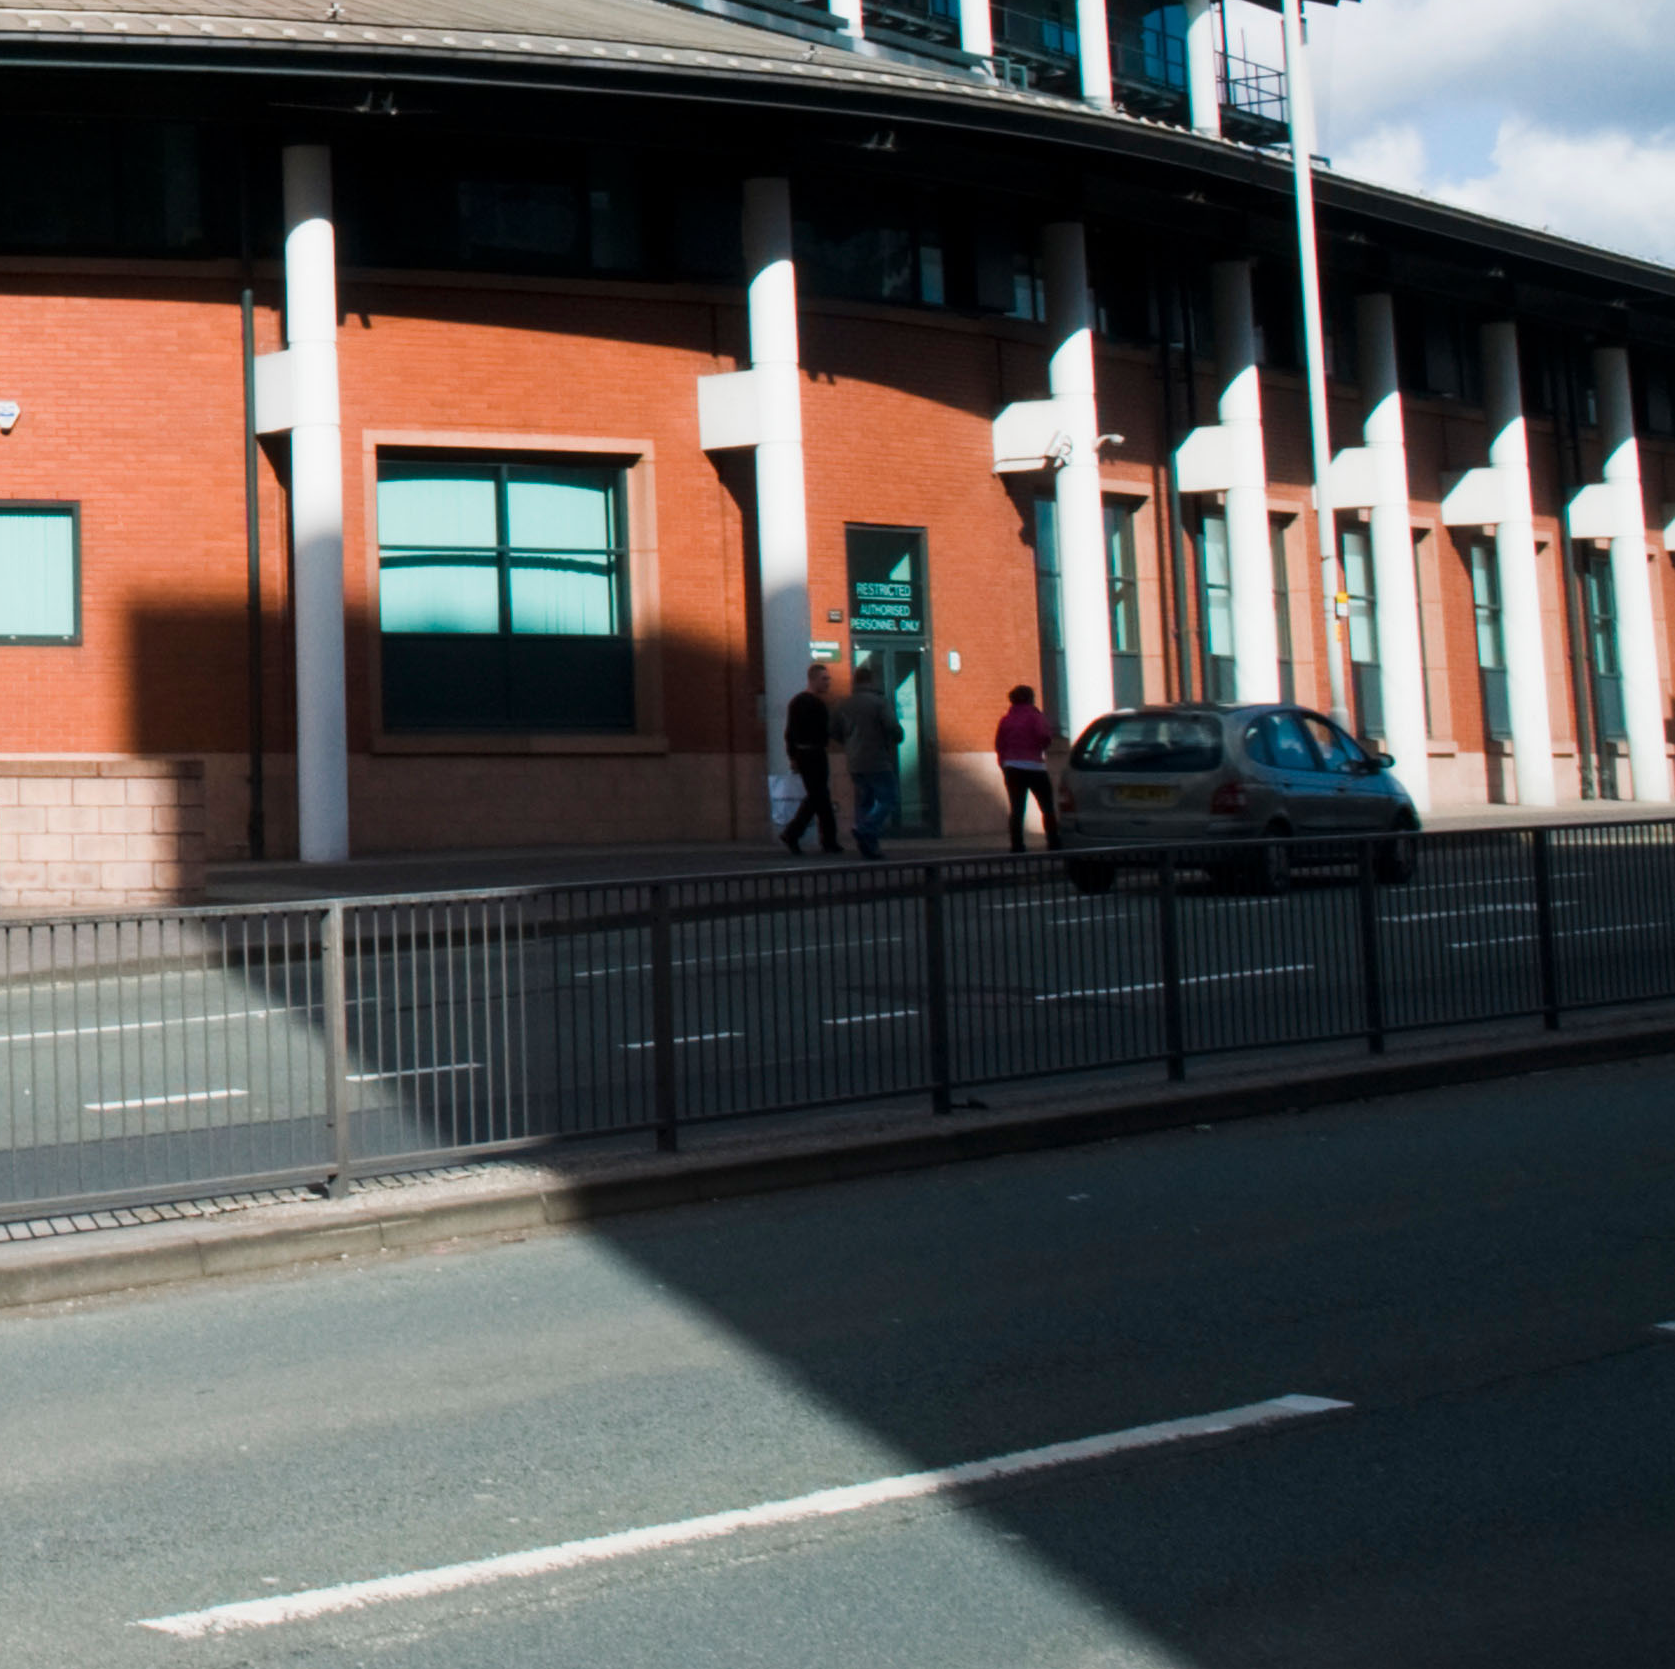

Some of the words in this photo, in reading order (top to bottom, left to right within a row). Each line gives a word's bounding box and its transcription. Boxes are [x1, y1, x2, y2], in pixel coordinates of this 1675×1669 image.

[856, 582, 911, 597] RESTRICTED
[860, 603, 910, 616] AUTHORISED
[850, 617, 898, 631] PERSONNEL
[899, 619, 920, 631] ONLY
